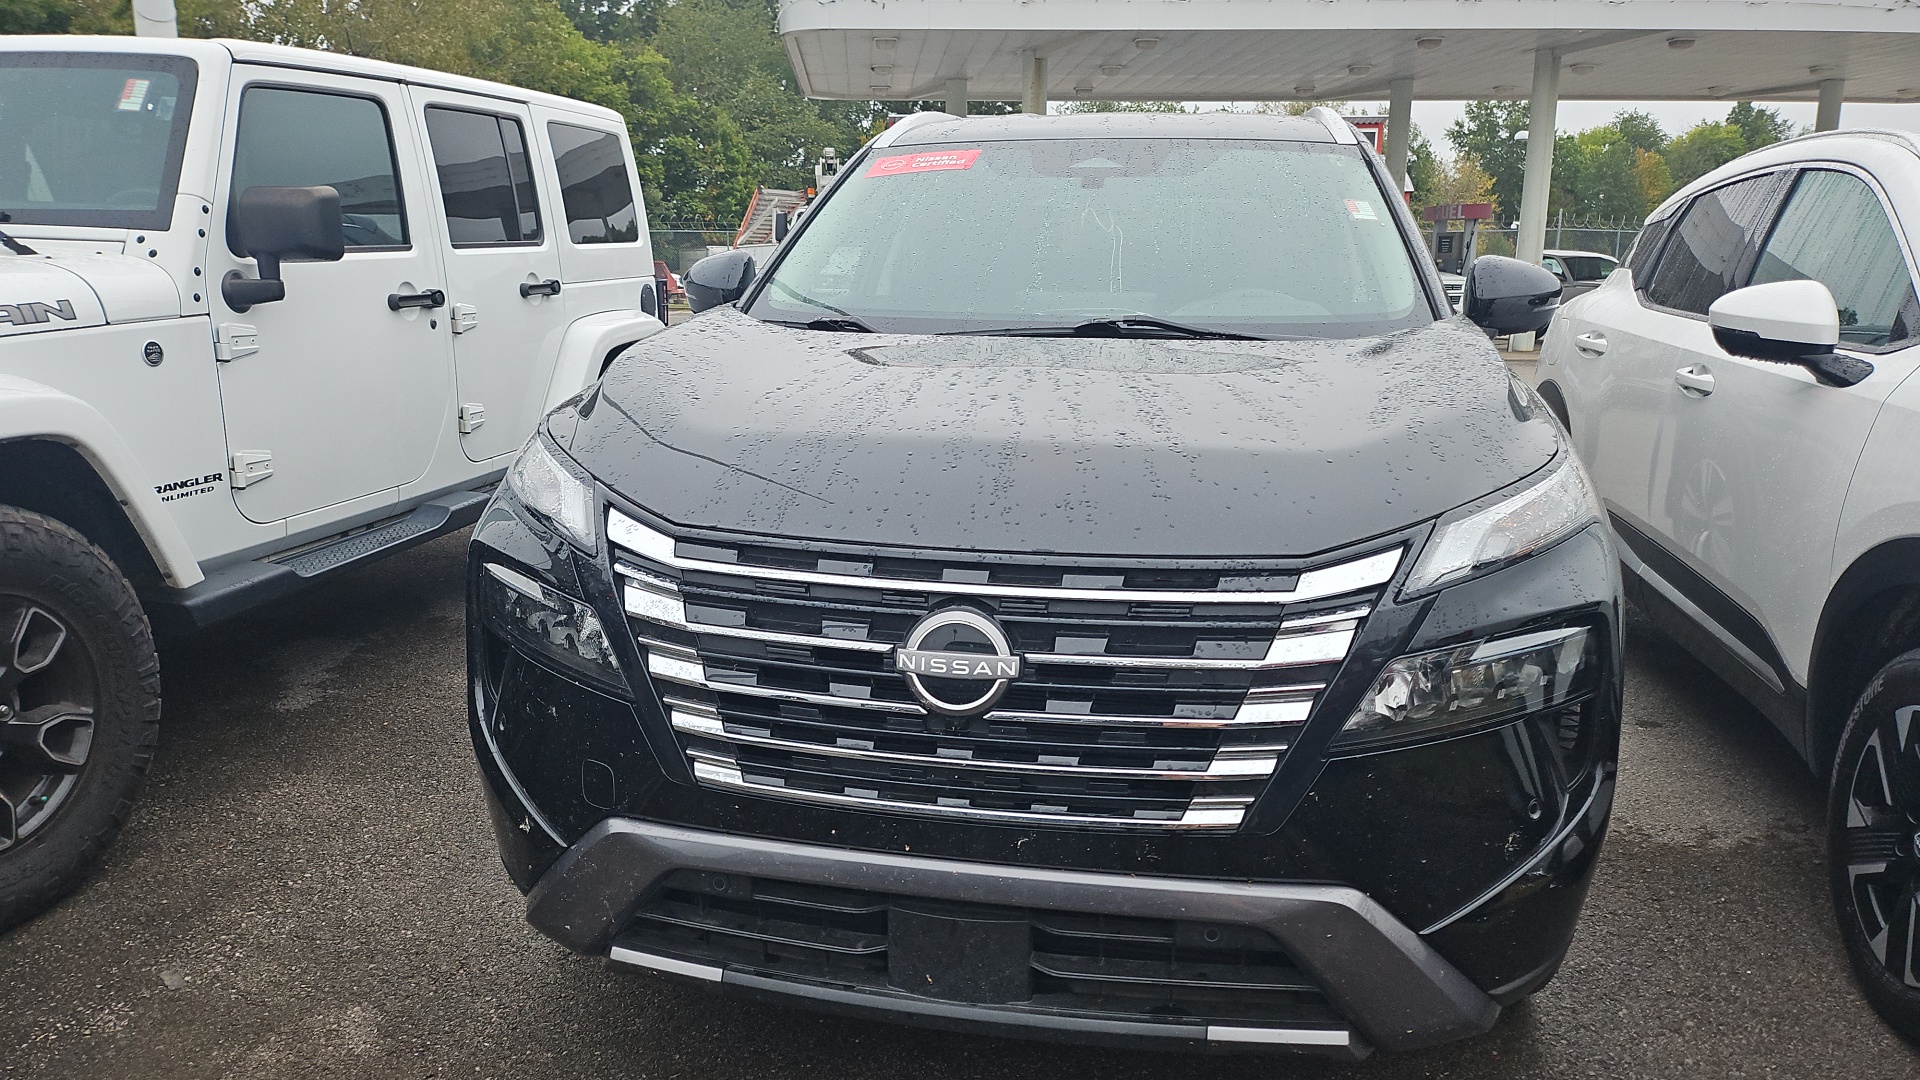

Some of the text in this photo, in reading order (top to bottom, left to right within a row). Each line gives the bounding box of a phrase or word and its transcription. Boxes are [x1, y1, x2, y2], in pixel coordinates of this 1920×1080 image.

[911, 159, 966, 168] Certified
[914, 155, 957, 163] Nissan
[899, 654, 1016, 677] NISSAN
